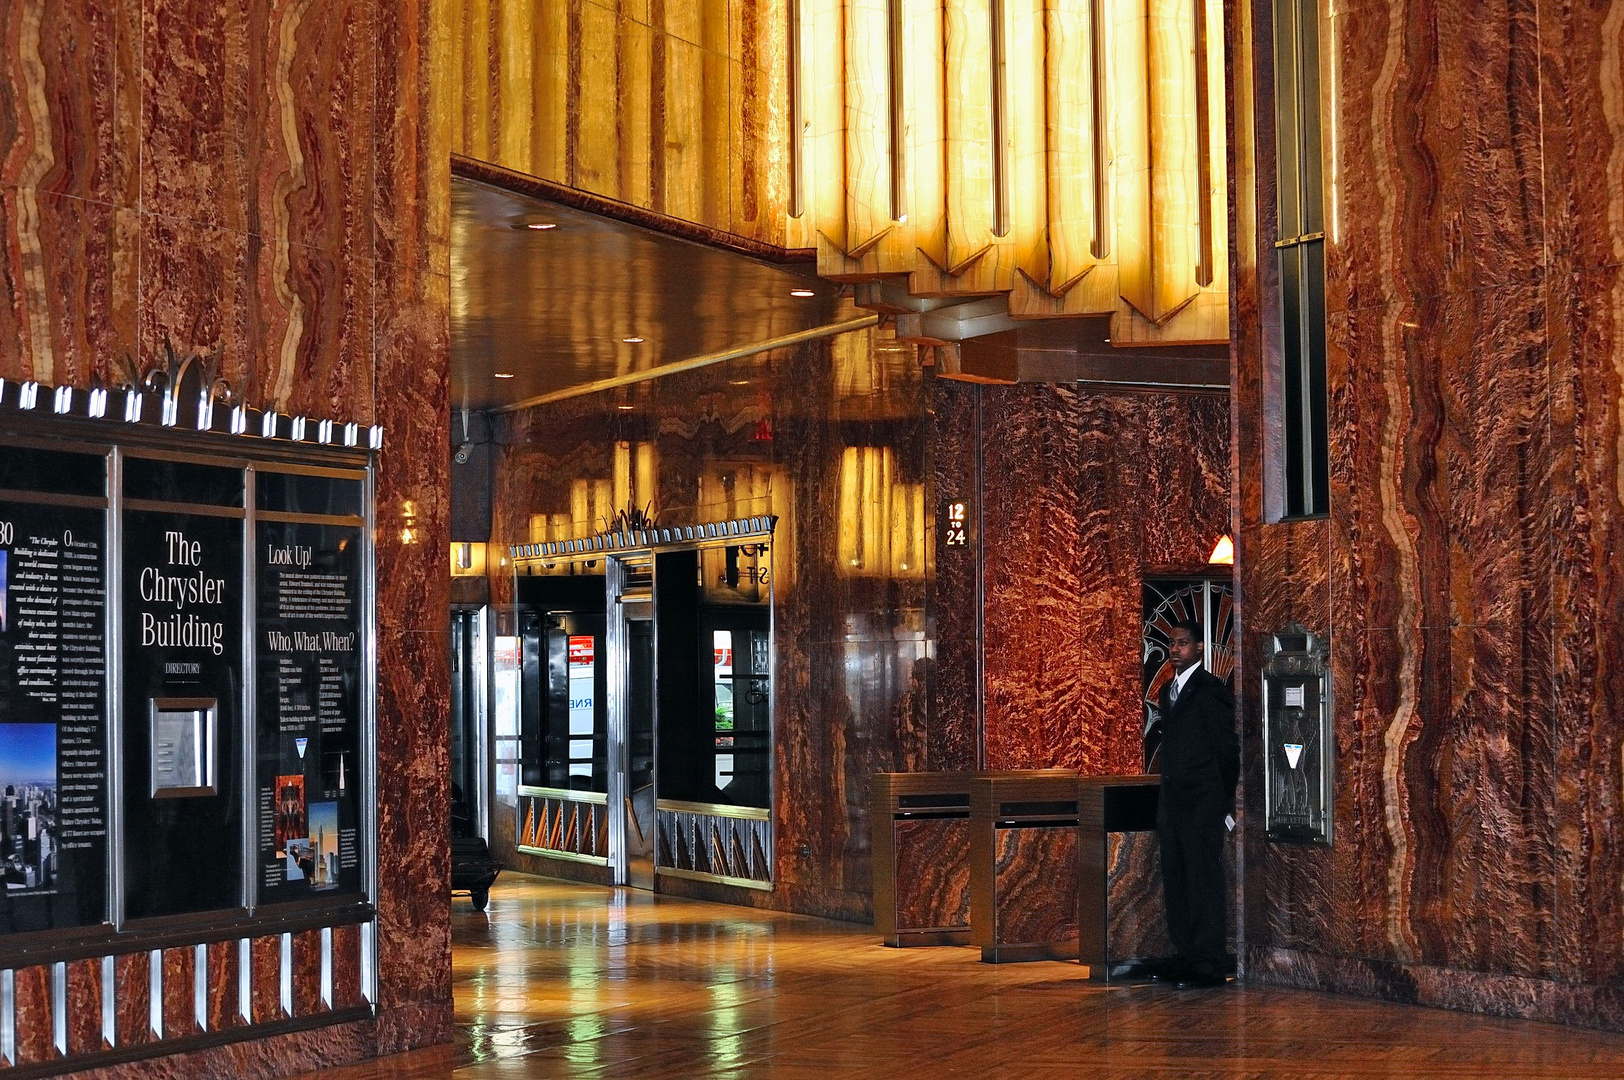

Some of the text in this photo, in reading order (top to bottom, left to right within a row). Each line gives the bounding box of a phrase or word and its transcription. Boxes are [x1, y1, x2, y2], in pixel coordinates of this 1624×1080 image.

[948, 503, 964, 519] 12
[165, 531, 201, 566] The
[947, 530, 965, 544] 24
[268, 544, 312, 569] Look Up!
[140, 567, 225, 609] Chrysler
[141, 613, 223, 655] Building
[268, 632, 354, 653] Who, What, When?
[165, 663, 200, 674] DIRECTORY
